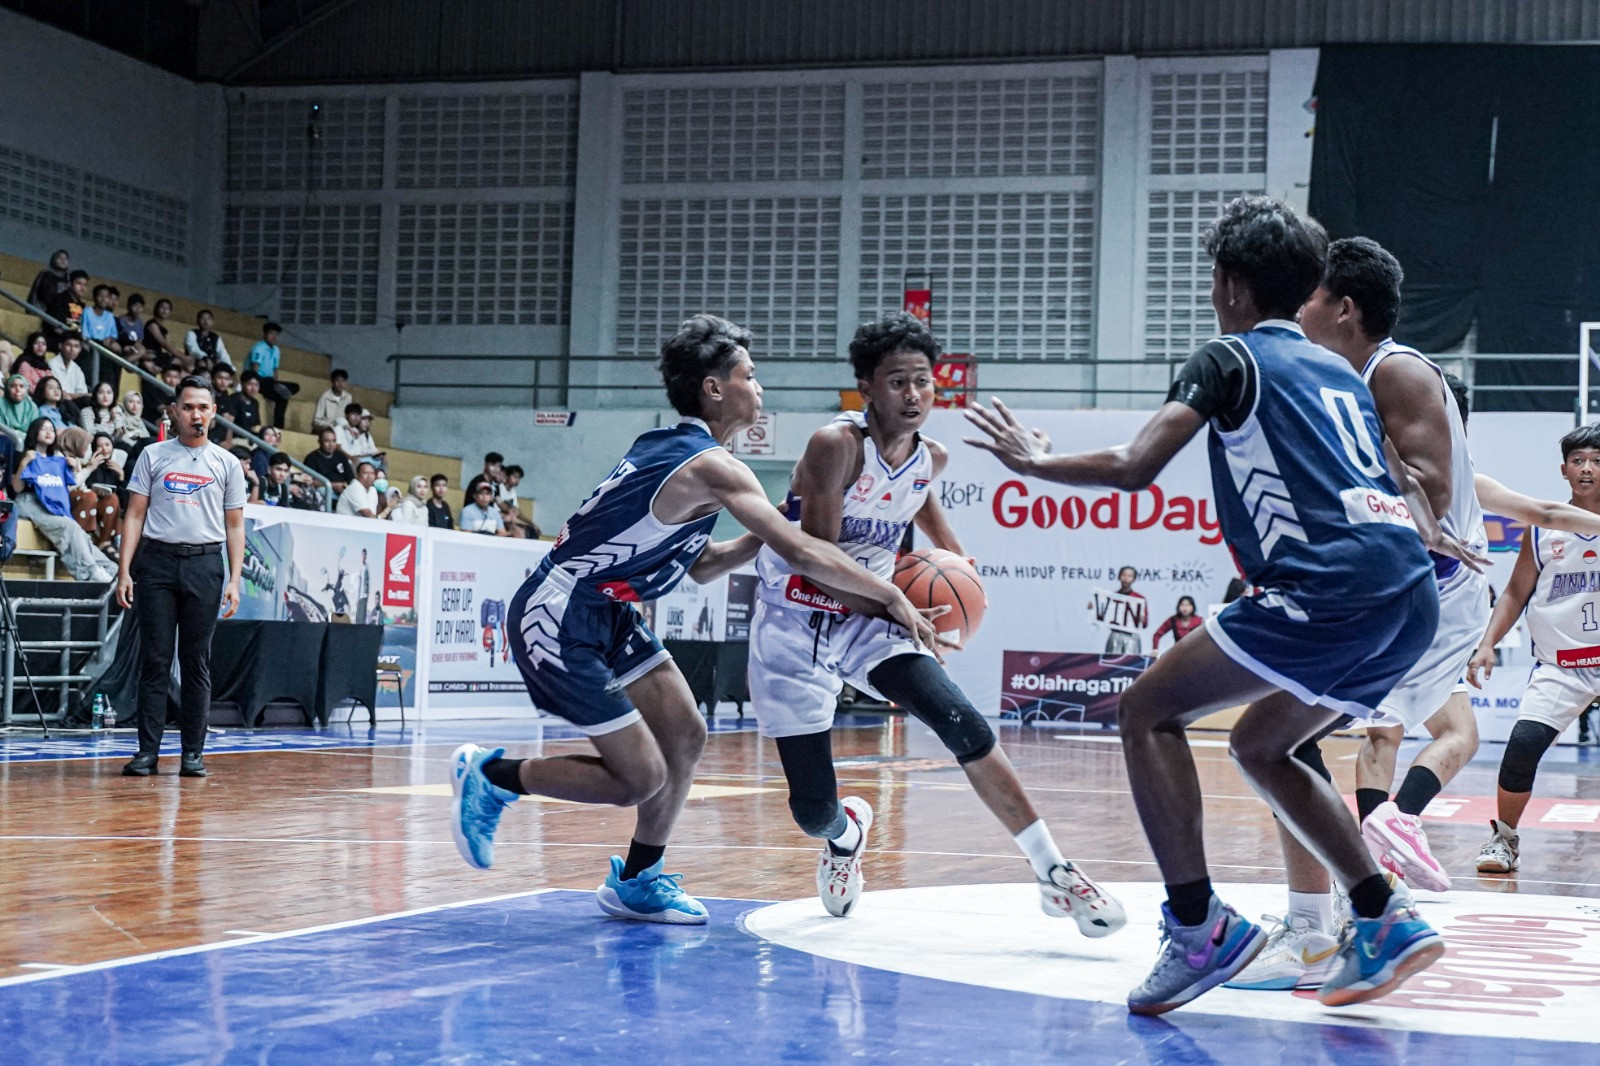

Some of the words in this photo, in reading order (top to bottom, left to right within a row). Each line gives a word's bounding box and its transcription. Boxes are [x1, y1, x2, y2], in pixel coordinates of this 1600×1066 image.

[176, 475, 203, 483] HONDA
[940, 480, 985, 509] Kopi
[992, 480, 1120, 530] Good
[1129, 484, 1224, 545] Day
[388, 573, 411, 582] HONDA
[1015, 565, 1055, 579] HIDUP
[1061, 566, 1102, 580] PERLU
[1172, 569, 1204, 582] RASA
[441, 588, 461, 612] GEAR
[791, 588, 811, 602] One
[435, 620, 453, 644] PLAY
[1560, 659, 1576, 667] One
